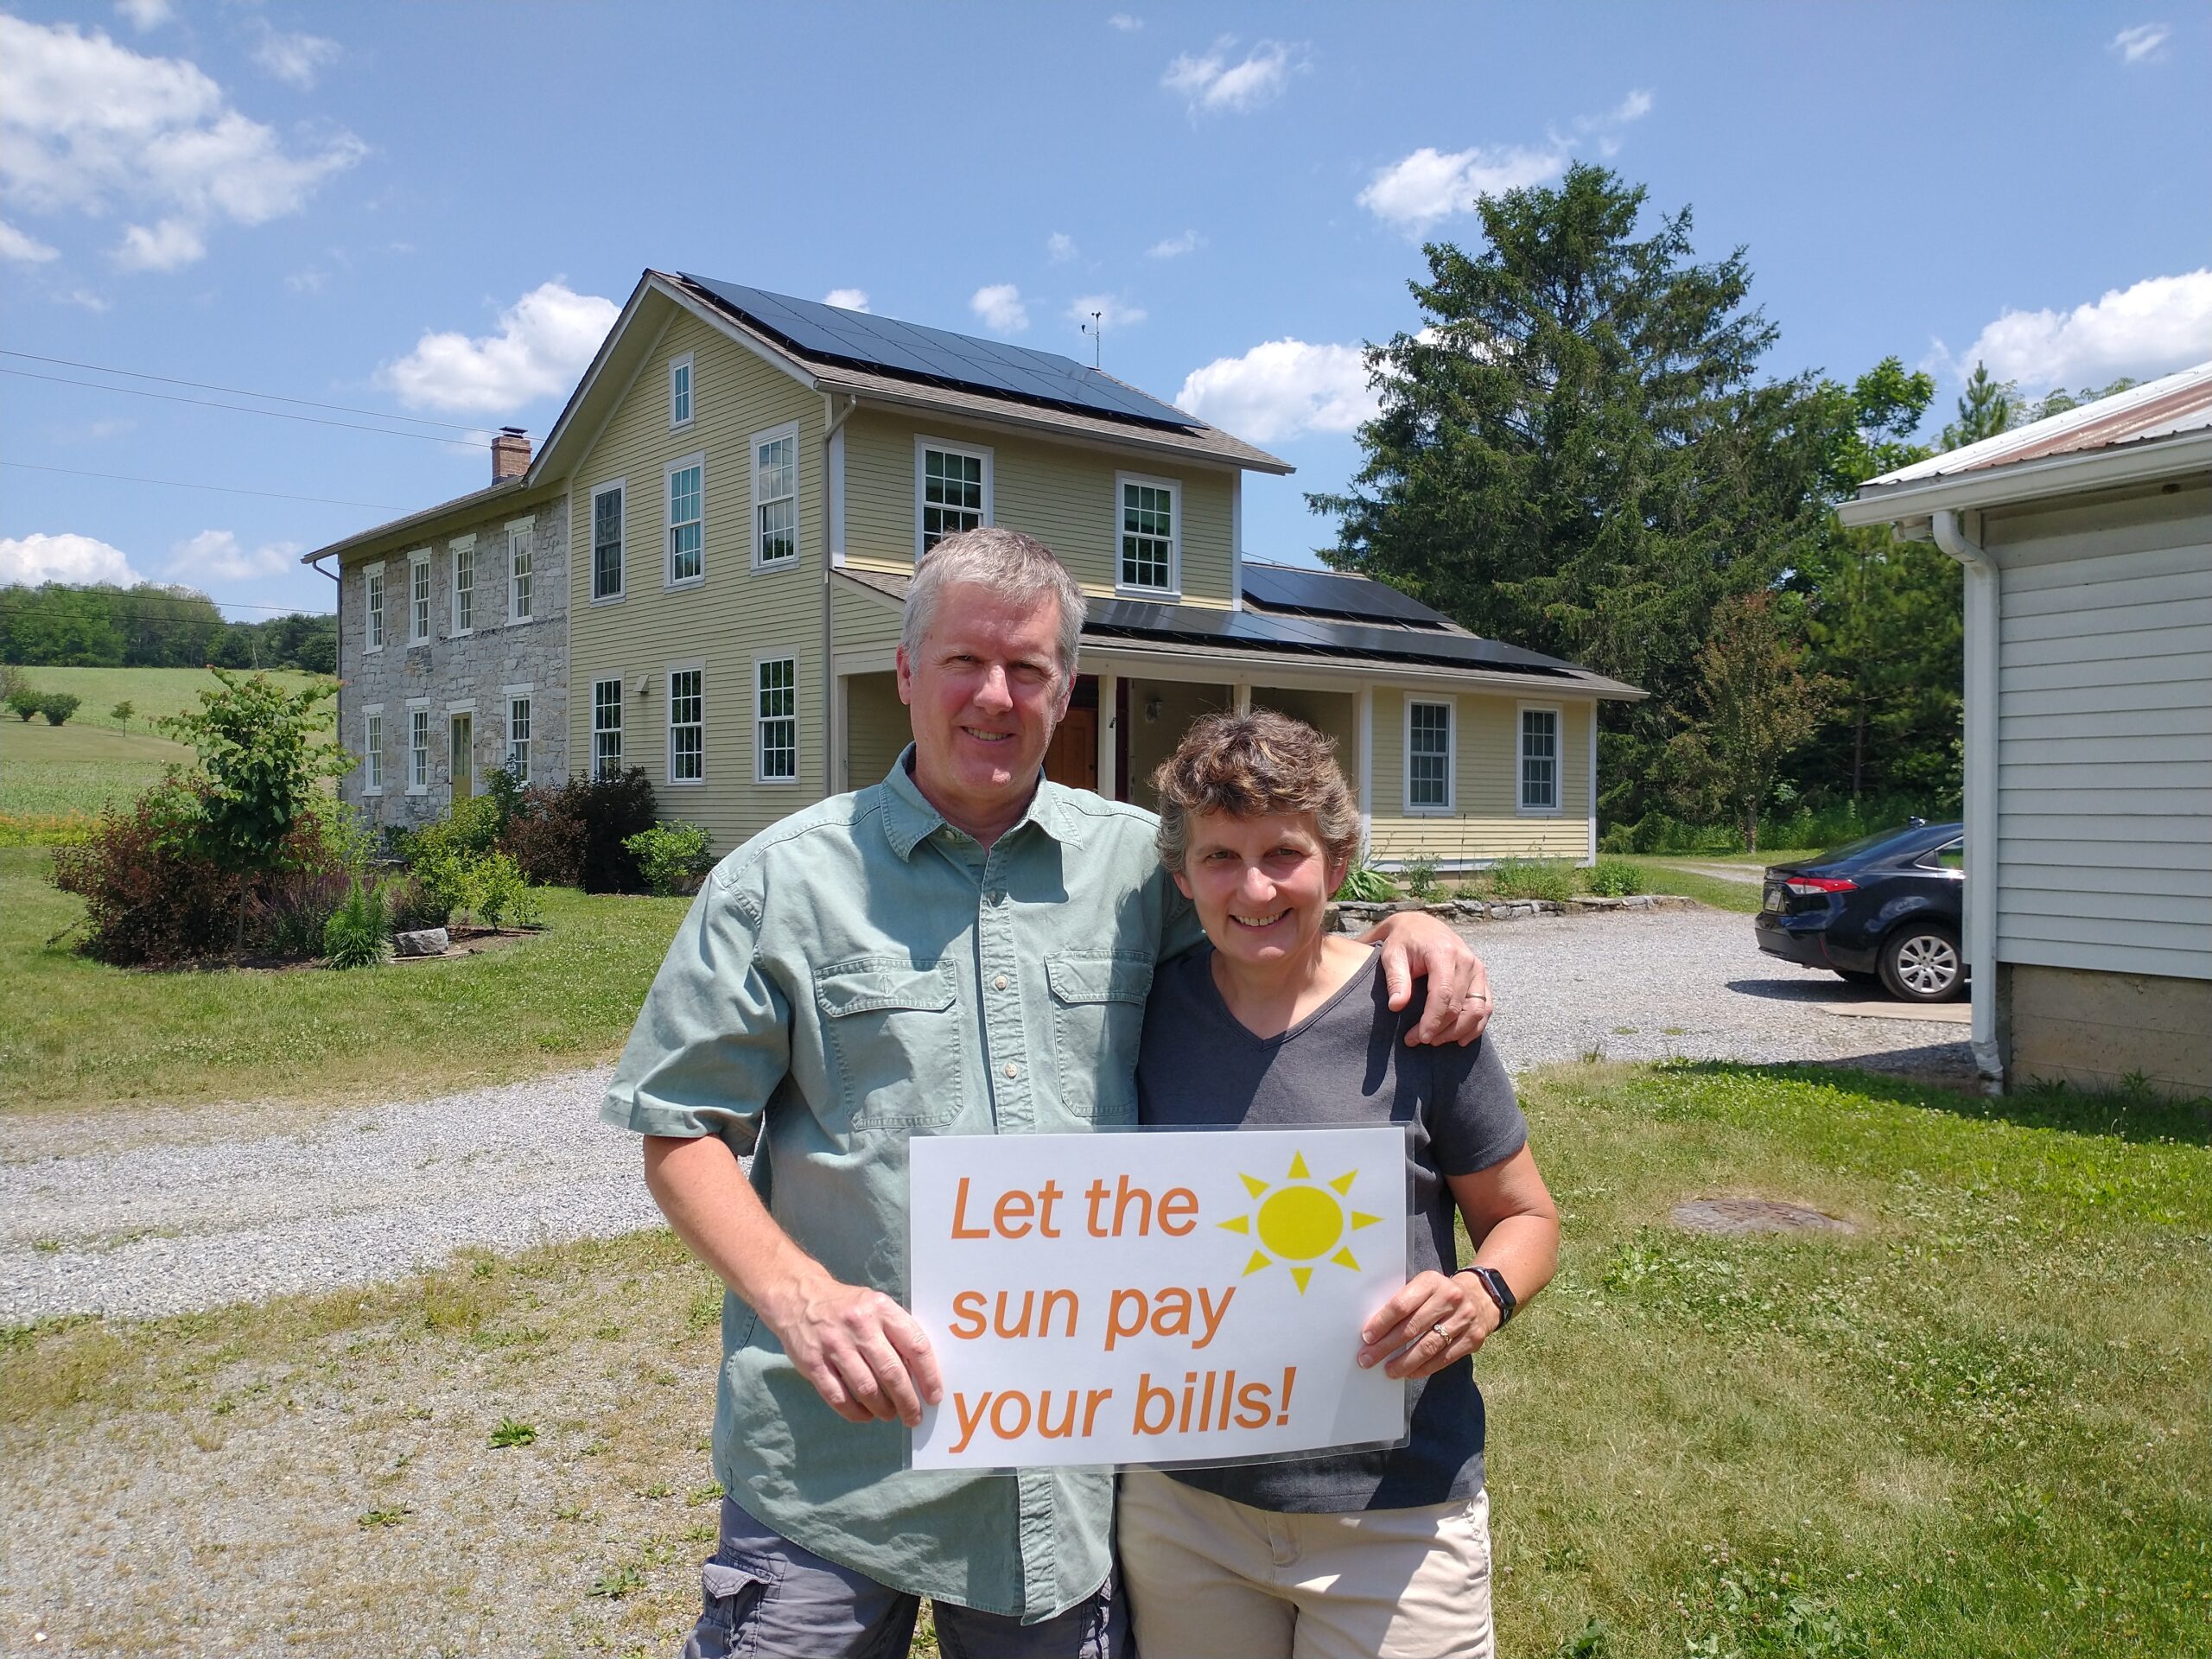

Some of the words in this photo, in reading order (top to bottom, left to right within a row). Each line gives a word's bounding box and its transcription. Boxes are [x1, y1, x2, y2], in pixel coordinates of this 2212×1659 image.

[950, 1177, 1064, 1239] Let
[1084, 1175, 1199, 1237] the
[949, 1288, 1079, 1339] sun
[1104, 1286, 1236, 1351] pay
[949, 1389, 1112, 1453] your
[1132, 1366, 1297, 1435] bills!
